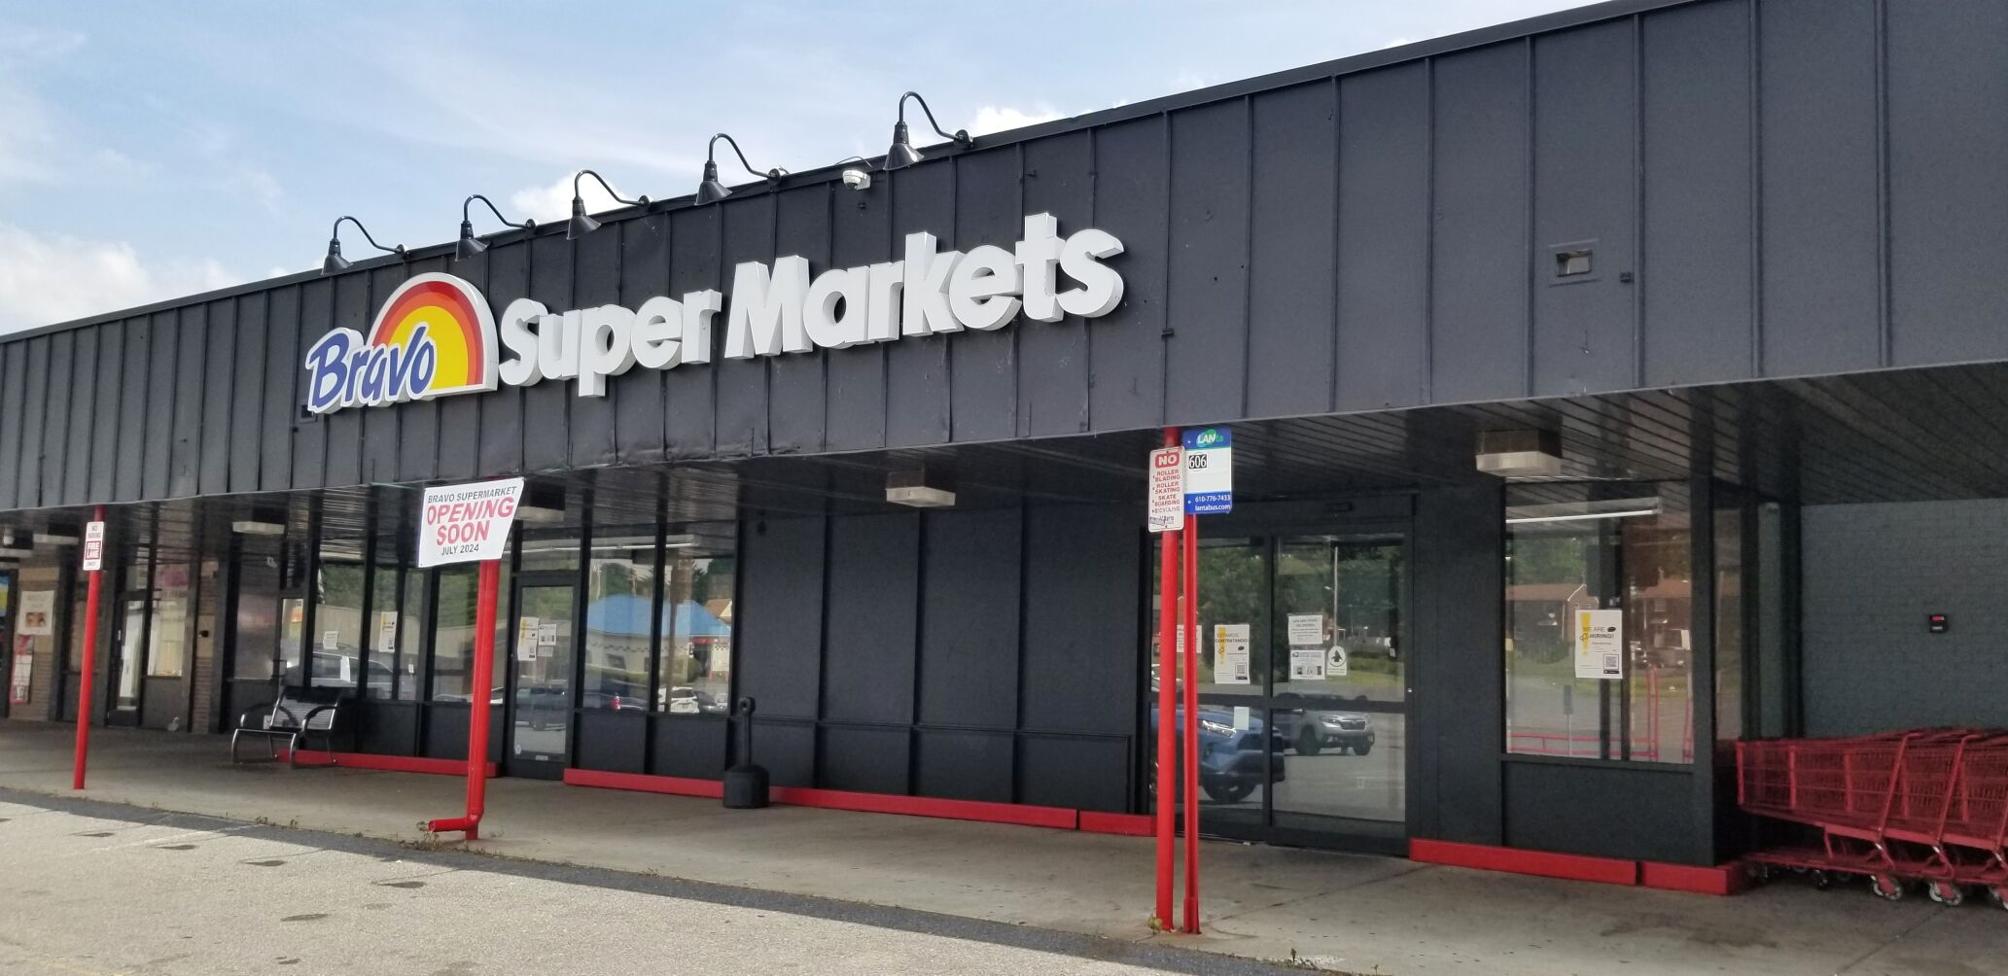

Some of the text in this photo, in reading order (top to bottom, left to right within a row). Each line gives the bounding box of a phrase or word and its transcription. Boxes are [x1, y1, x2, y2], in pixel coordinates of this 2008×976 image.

[306, 212, 1124, 411] Bravo Super Markets
[1158, 454, 1177, 466] NO
[1189, 455, 1207, 468] 606
[428, 486, 517, 504] BRAVO SUPERMARKET
[427, 496, 515, 525] OPENING
[436, 519, 490, 546] SOON
[441, 544, 480, 556] JULY 2024
